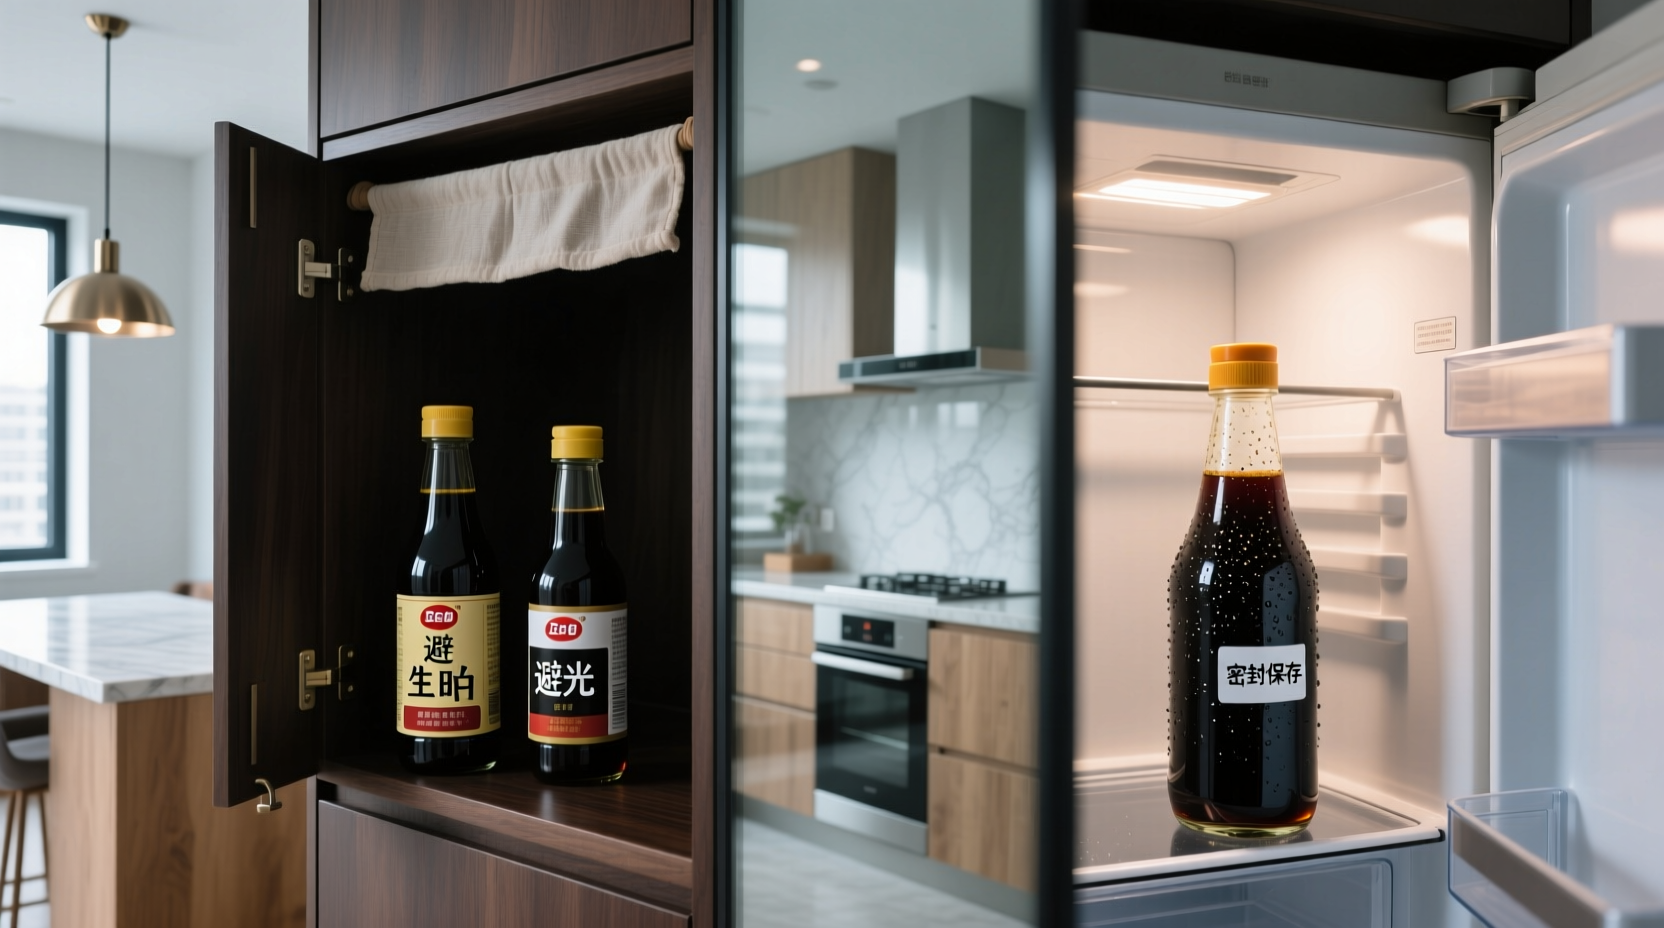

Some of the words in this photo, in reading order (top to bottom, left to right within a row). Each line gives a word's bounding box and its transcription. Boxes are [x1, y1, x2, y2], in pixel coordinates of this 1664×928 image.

[424, 634, 454, 664] 避
[534, 660, 595, 697] 避光
[1227, 661, 1302, 687] 密封保存
